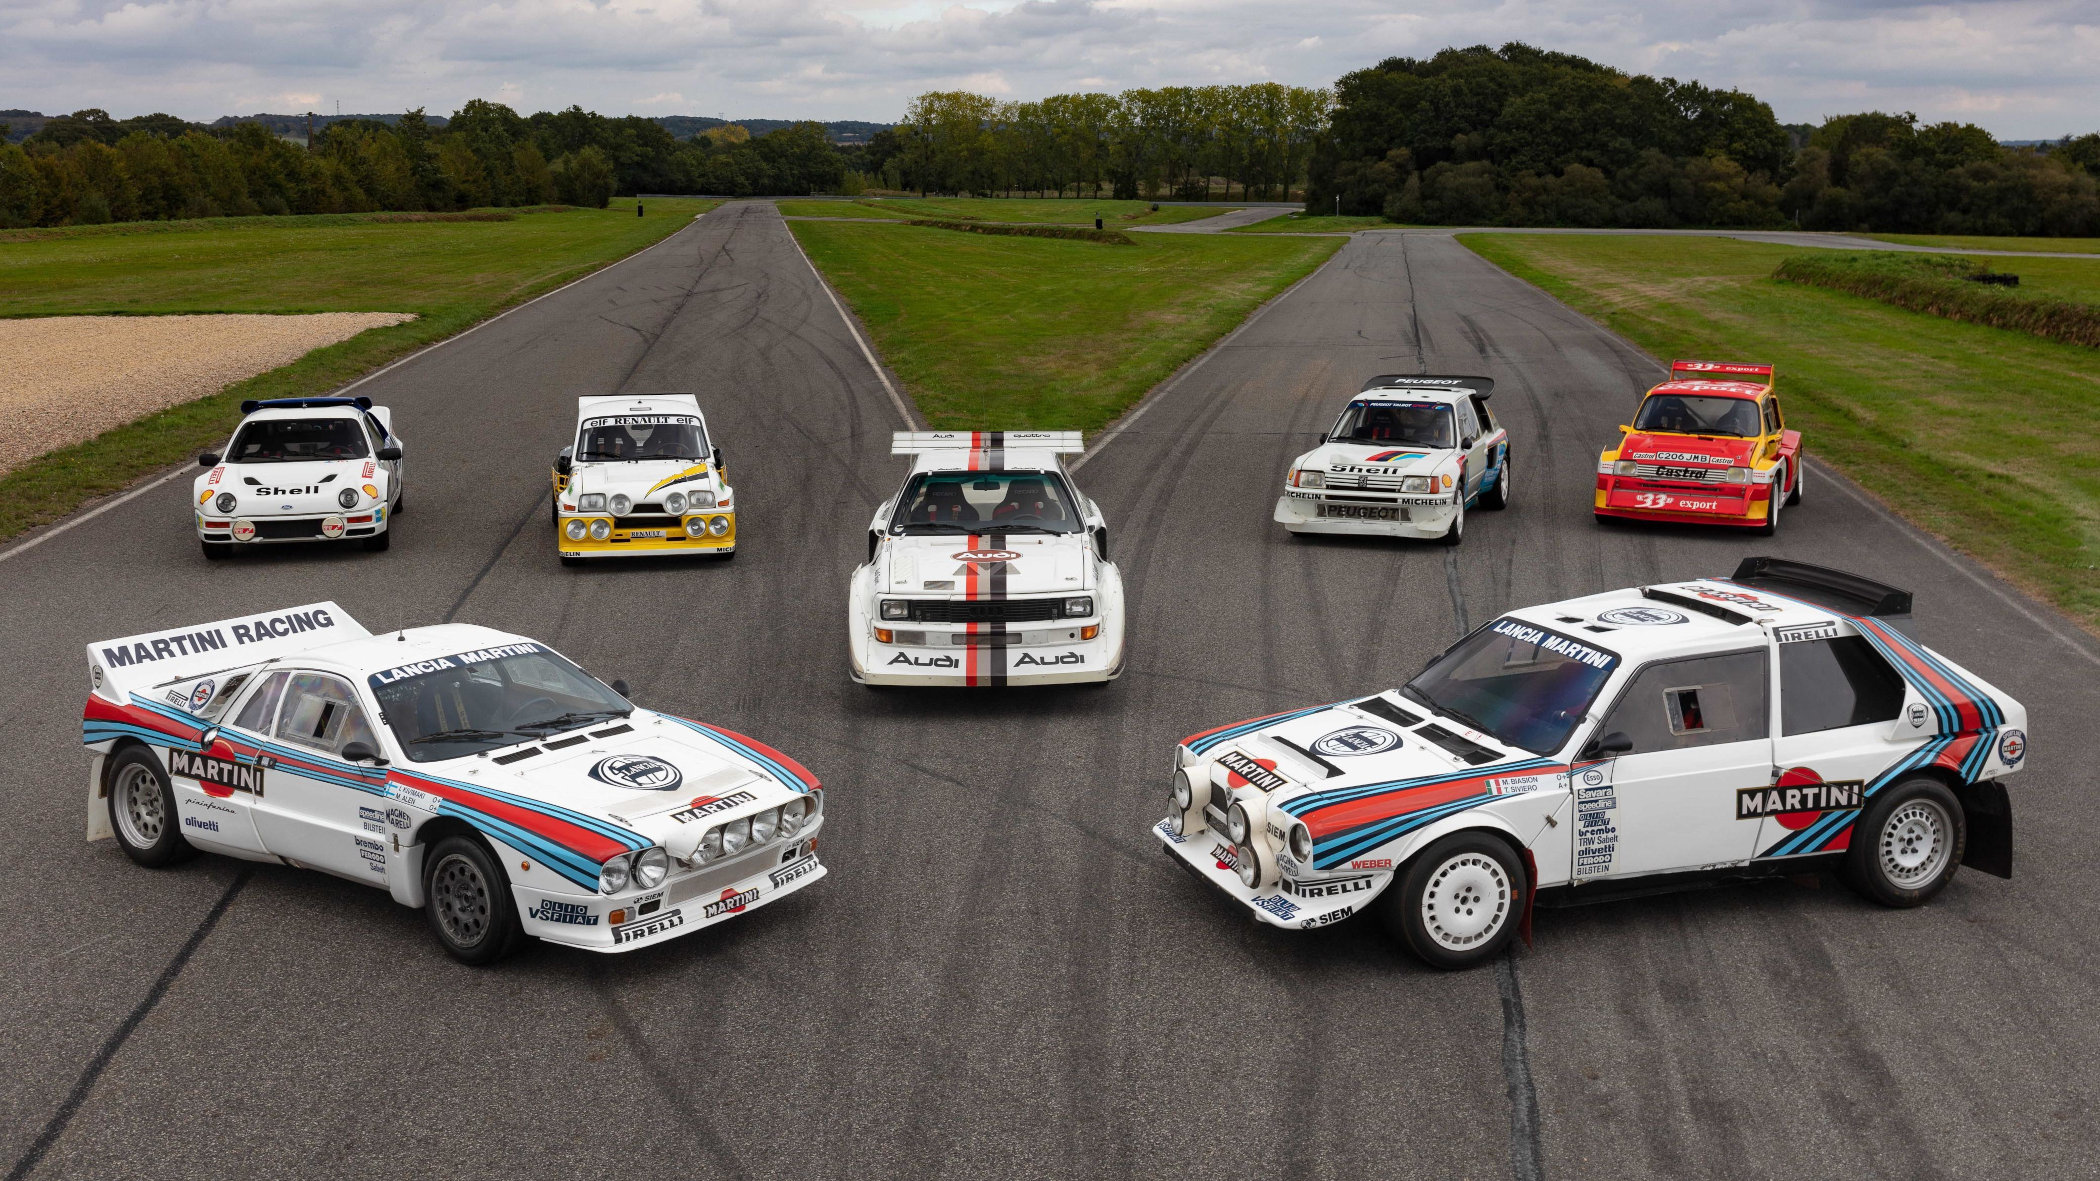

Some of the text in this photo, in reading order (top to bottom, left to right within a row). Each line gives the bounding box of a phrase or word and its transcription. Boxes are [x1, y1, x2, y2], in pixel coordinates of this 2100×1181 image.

[1394, 378, 1464, 386] PEUGEOT
[1657, 384, 1756, 397] export
[590, 416, 694, 427] elf RENAULT elf
[1633, 452, 1656, 460] Castrol
[1657, 452, 1708, 463] C206 JMB
[1711, 457, 1734, 465] Castrol
[207, 466, 225, 485] PIRELLI
[362, 461, 377, 479] PIRELLI
[1330, 464, 1399, 475] Shell
[1655, 465, 1709, 479] Castrol
[255, 485, 320, 497] Shell
[1401, 498, 1447, 507] MICHELIN
[1679, 498, 1718, 511] export
[1329, 504, 1398, 520] PEUGEOT
[956, 550, 1020, 560] Audi
[1772, 620, 1839, 643] PIRELLI
[101, 608, 336, 669] MARTINI RACING
[1492, 620, 1613, 669] LANCIA MARTINI
[375, 642, 541, 685] LANCIA MARTINI
[887, 651, 960, 669] Audi
[1013, 650, 1086, 668] Audi
[165, 689, 189, 709] PIRELLI
[172, 751, 262, 793] MARTINI
[622, 761, 659, 776] LANCIA
[1218, 751, 1284, 794] MARTINI
[1510, 776, 1539, 785] BIASION
[1585, 772, 1601, 783] Esso
[1510, 784, 1538, 793] SIVIERO
[1578, 788, 1613, 799] Savara
[401, 795, 416, 805] ALEN
[1741, 784, 1860, 815] MARTINI
[678, 792, 756, 823] MARTINI
[1579, 811, 1605, 822] OLIO
[1583, 818, 1610, 828] FIAT
[185, 816, 219, 833] olivetti
[1578, 825, 1617, 837] brembo
[1267, 821, 1286, 842] SIEM
[354, 835, 384, 852] brembo
[1578, 834, 1619, 847] TRW Sabelt
[360, 850, 385, 863] FERODO
[1577, 844, 1615, 857] olivetti
[1351, 858, 1393, 870] WEBER
[1578, 855, 1611, 866] FERODO
[768, 853, 818, 890] PIRELLI
[1576, 864, 1611, 876] BILSTEIN
[1292, 874, 1376, 899] PIRELLI
[644, 890, 665, 902] SIEM
[542, 900, 587, 915] OLIO
[705, 888, 759, 919] MARTINI
[528, 906, 599, 925] VS FIAT
[1319, 905, 1355, 925] SIEM
[610, 908, 684, 945] PIRELLI
